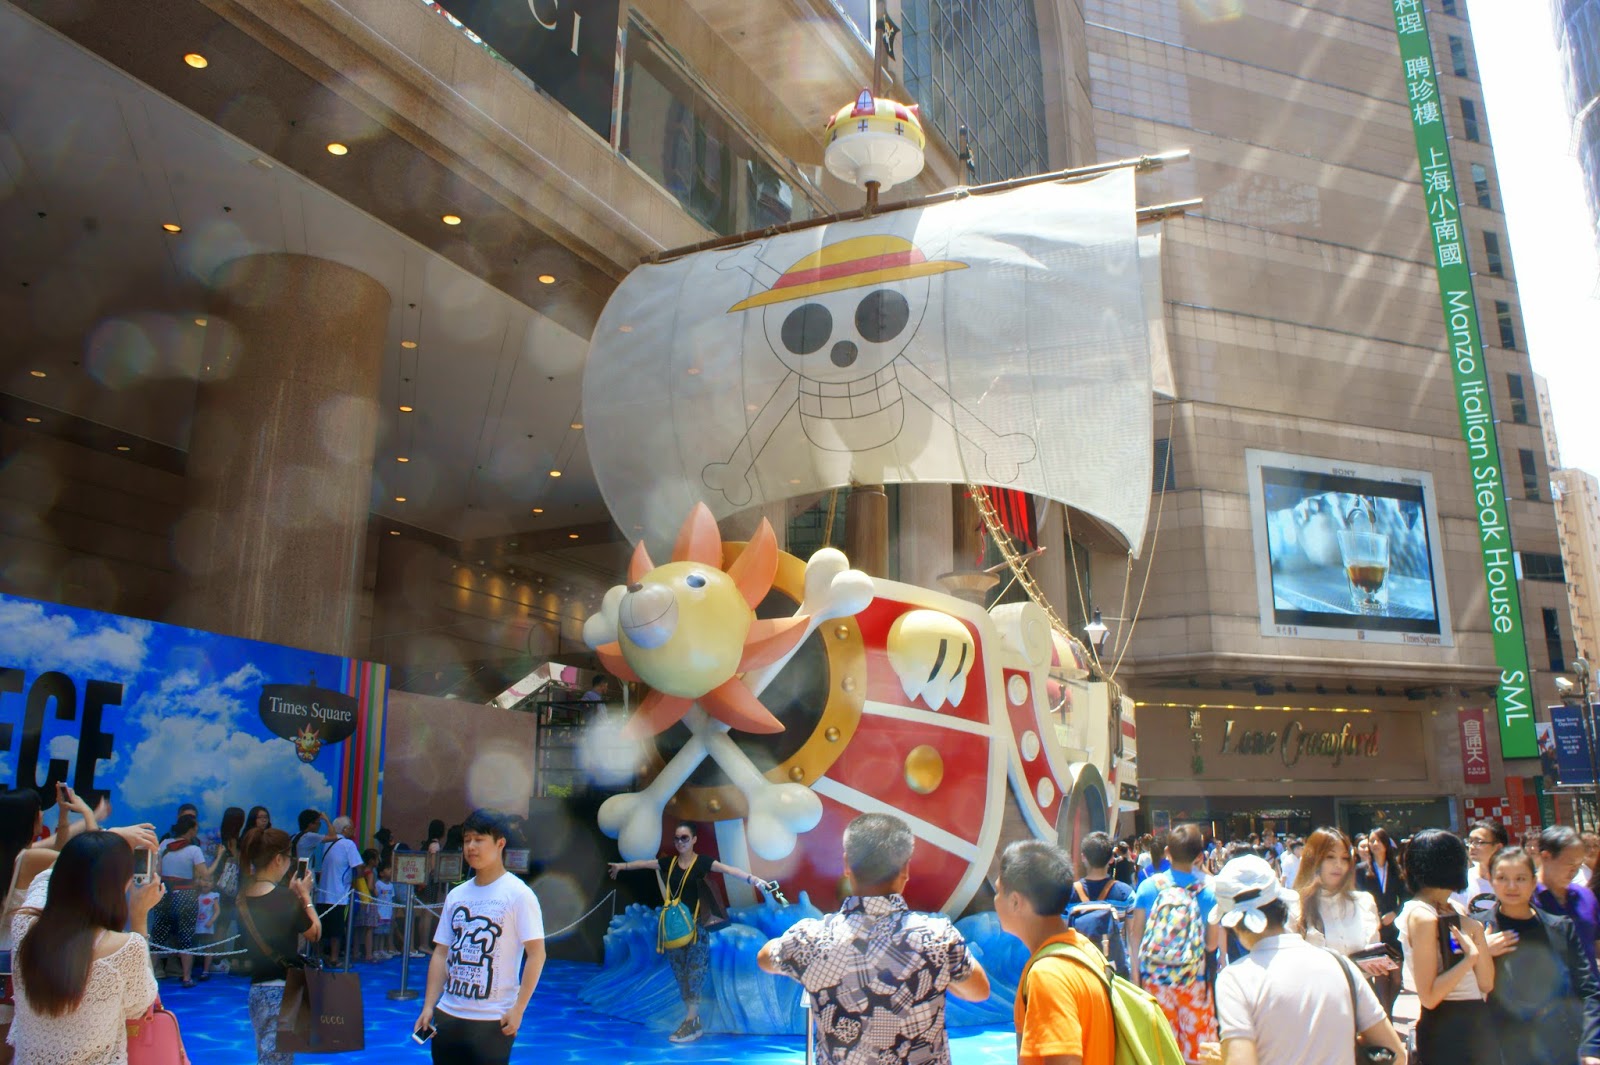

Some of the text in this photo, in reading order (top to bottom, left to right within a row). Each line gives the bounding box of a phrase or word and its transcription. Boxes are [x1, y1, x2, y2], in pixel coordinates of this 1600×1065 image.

[1405, 56, 1440, 125] 聘珍樓
[1423, 147, 1462, 268] 上海小南國
[1447, 290, 1513, 634] Manzo Italian Steak House
[1402, 632, 1440, 646] Times Square
[268, 696, 352, 723] Times Square
[1500, 670, 1530, 727] SML
[1220, 720, 1380, 769] Lane Crawford
[320, 1015, 345, 1025] GUCCI
